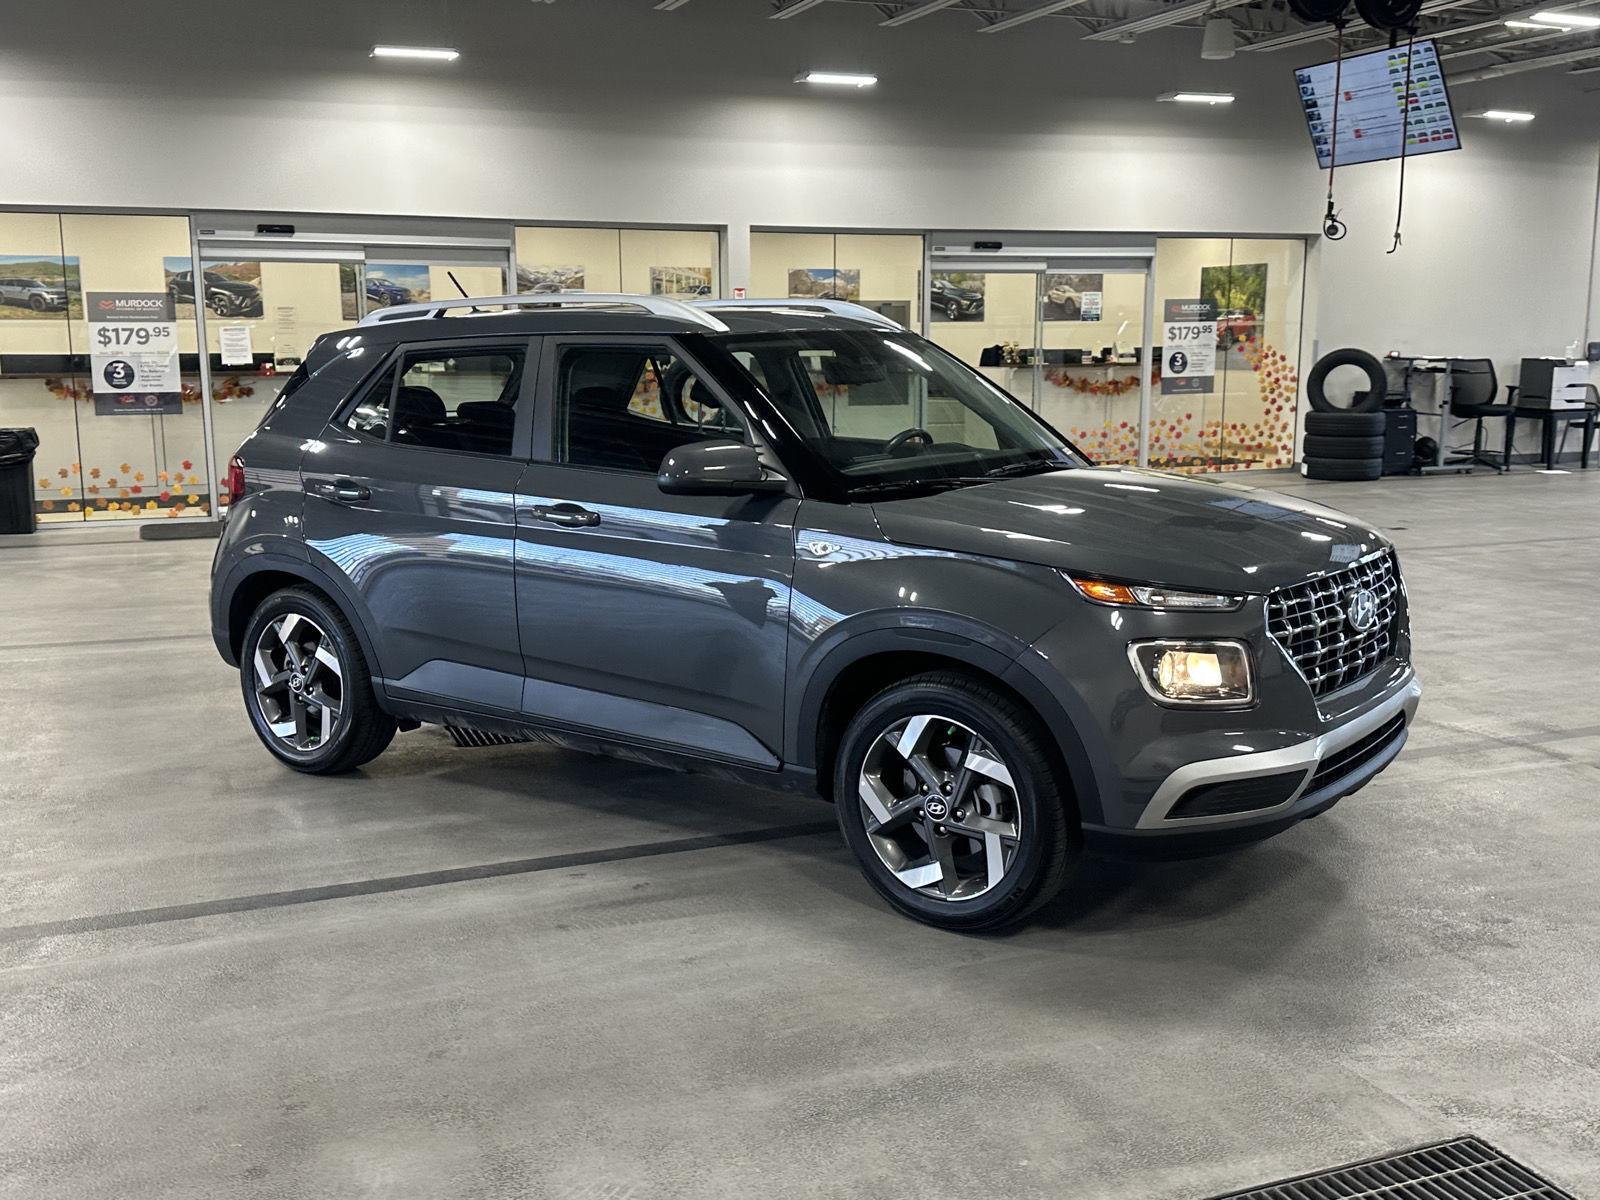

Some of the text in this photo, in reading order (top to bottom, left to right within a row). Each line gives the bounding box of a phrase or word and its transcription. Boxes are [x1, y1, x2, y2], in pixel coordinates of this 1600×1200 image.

[116, 300, 163, 308] MURDOCK
[1174, 354, 1182, 366] 3
[112, 362, 125, 378] 3
